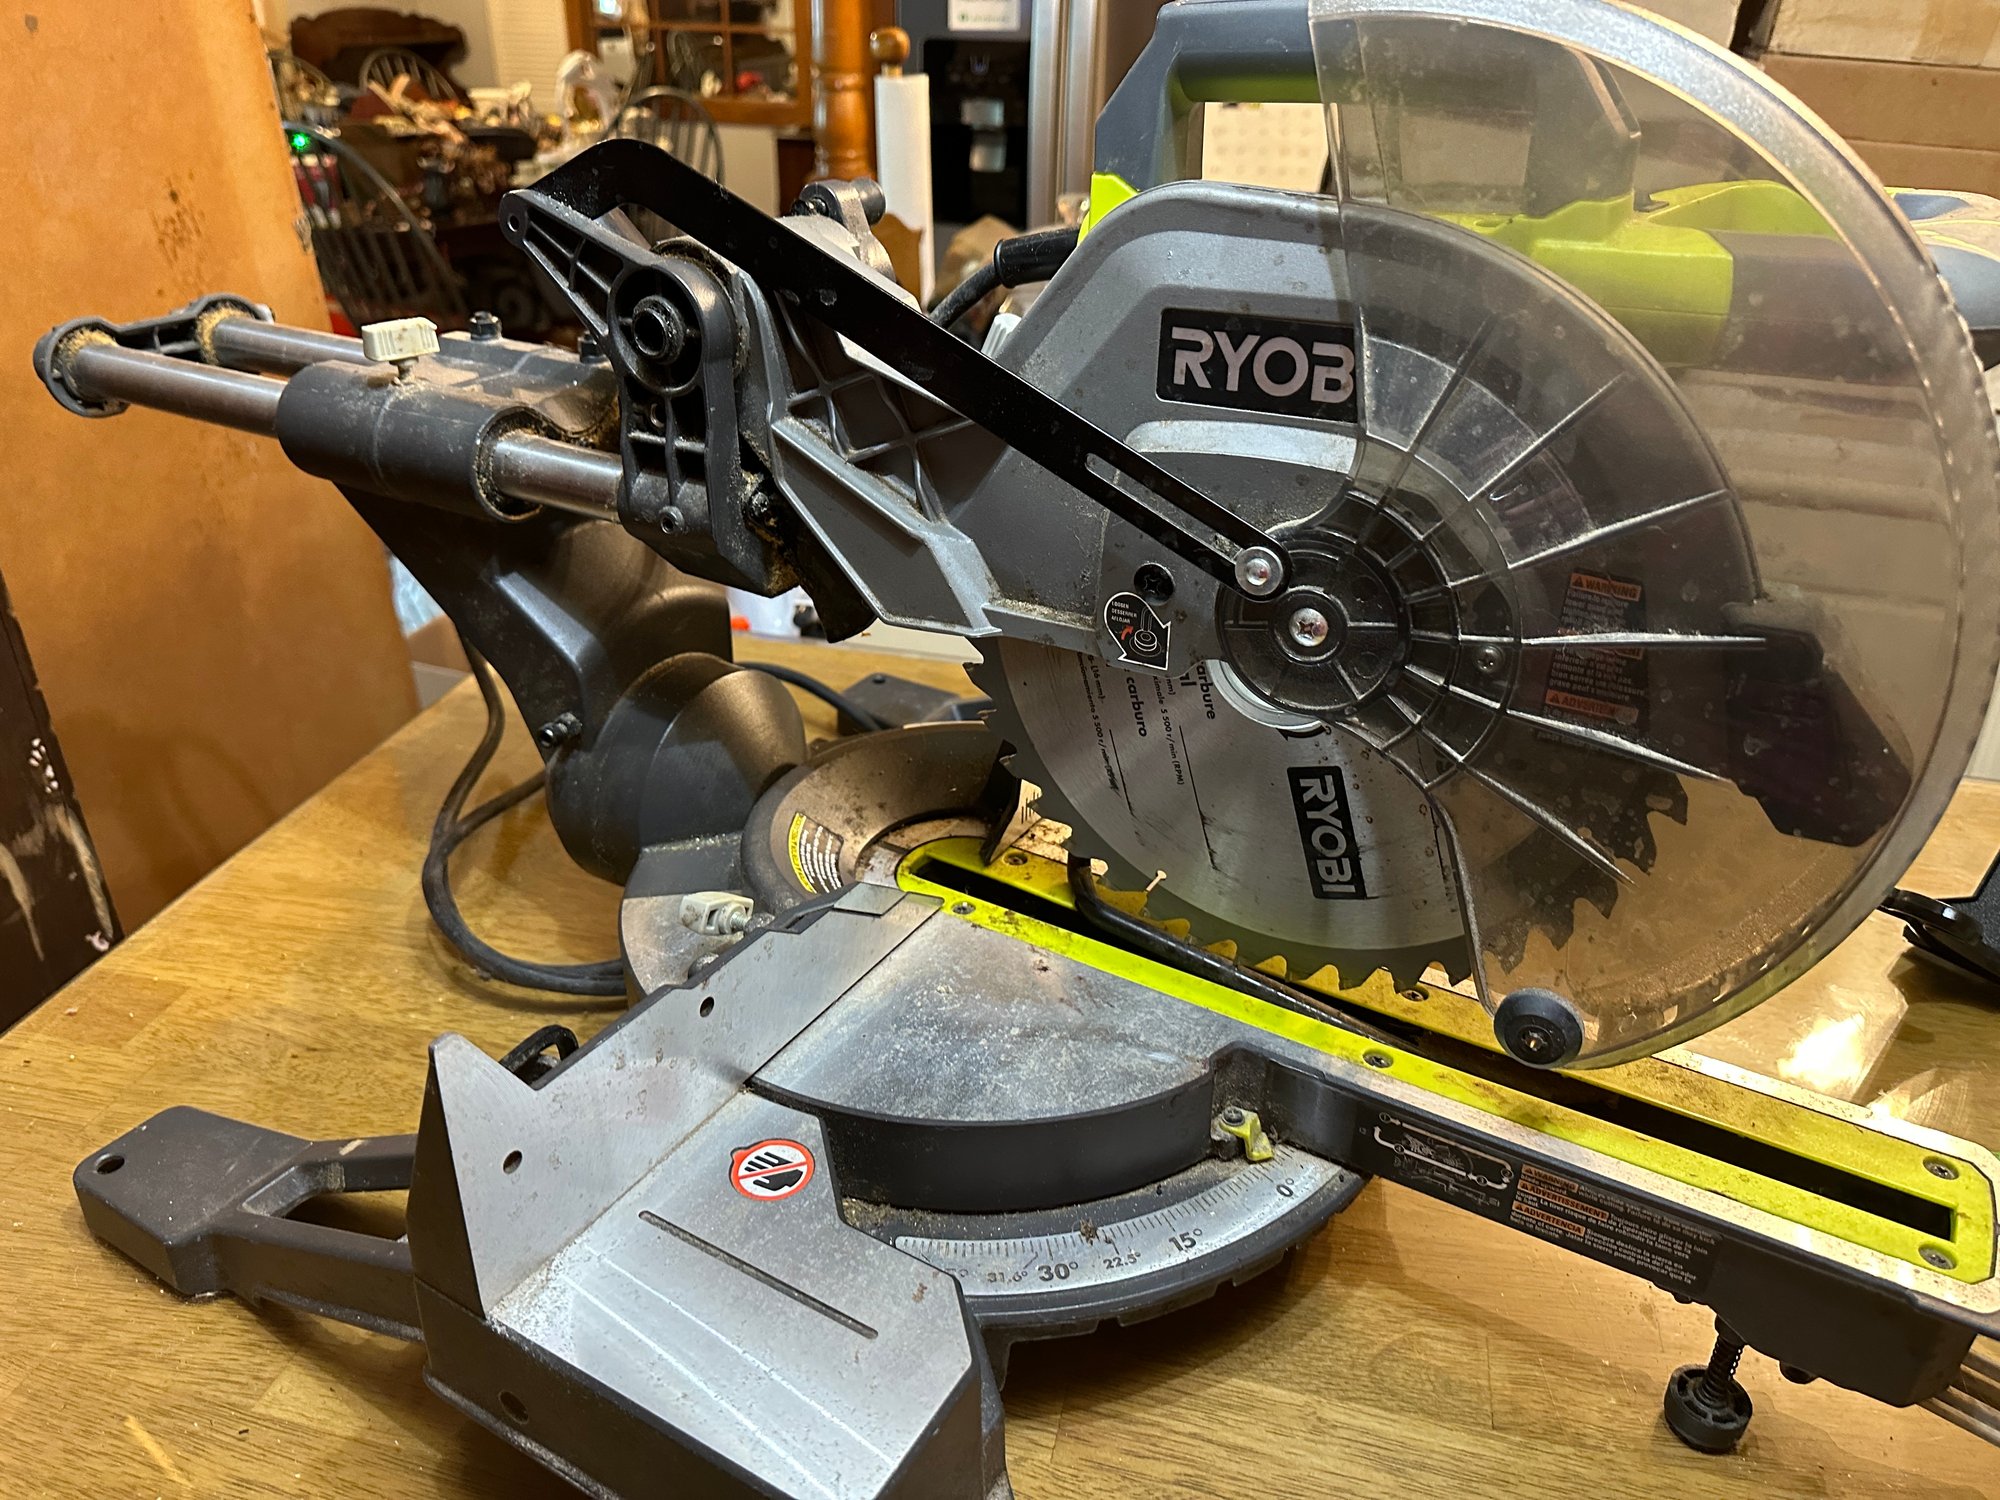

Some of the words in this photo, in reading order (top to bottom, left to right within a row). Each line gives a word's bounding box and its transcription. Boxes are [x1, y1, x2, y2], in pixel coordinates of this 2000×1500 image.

[1171, 326, 1355, 403] RYOB
[1585, 578, 1639, 599] WARNING
[1197, 663, 1215, 720] arbure
[1126, 676, 1147, 737] carburo
[1152, 675, 1165, 705] ximale
[1172, 760, 1184, 785] (RPM)
[1299, 775, 1356, 893] RYOBI
[1276, 1177, 1295, 1198] 0°
[1534, 1170, 1575, 1190] WARNING
[1531, 1185, 1605, 1218] ADVERTISSEMENT
[1524, 1207, 1580, 1233] ADVERTENCIA
[1169, 1229, 1203, 1253] 15°
[1038, 1261, 1079, 1282] 30°
[1103, 1252, 1141, 1270] 22.5°
